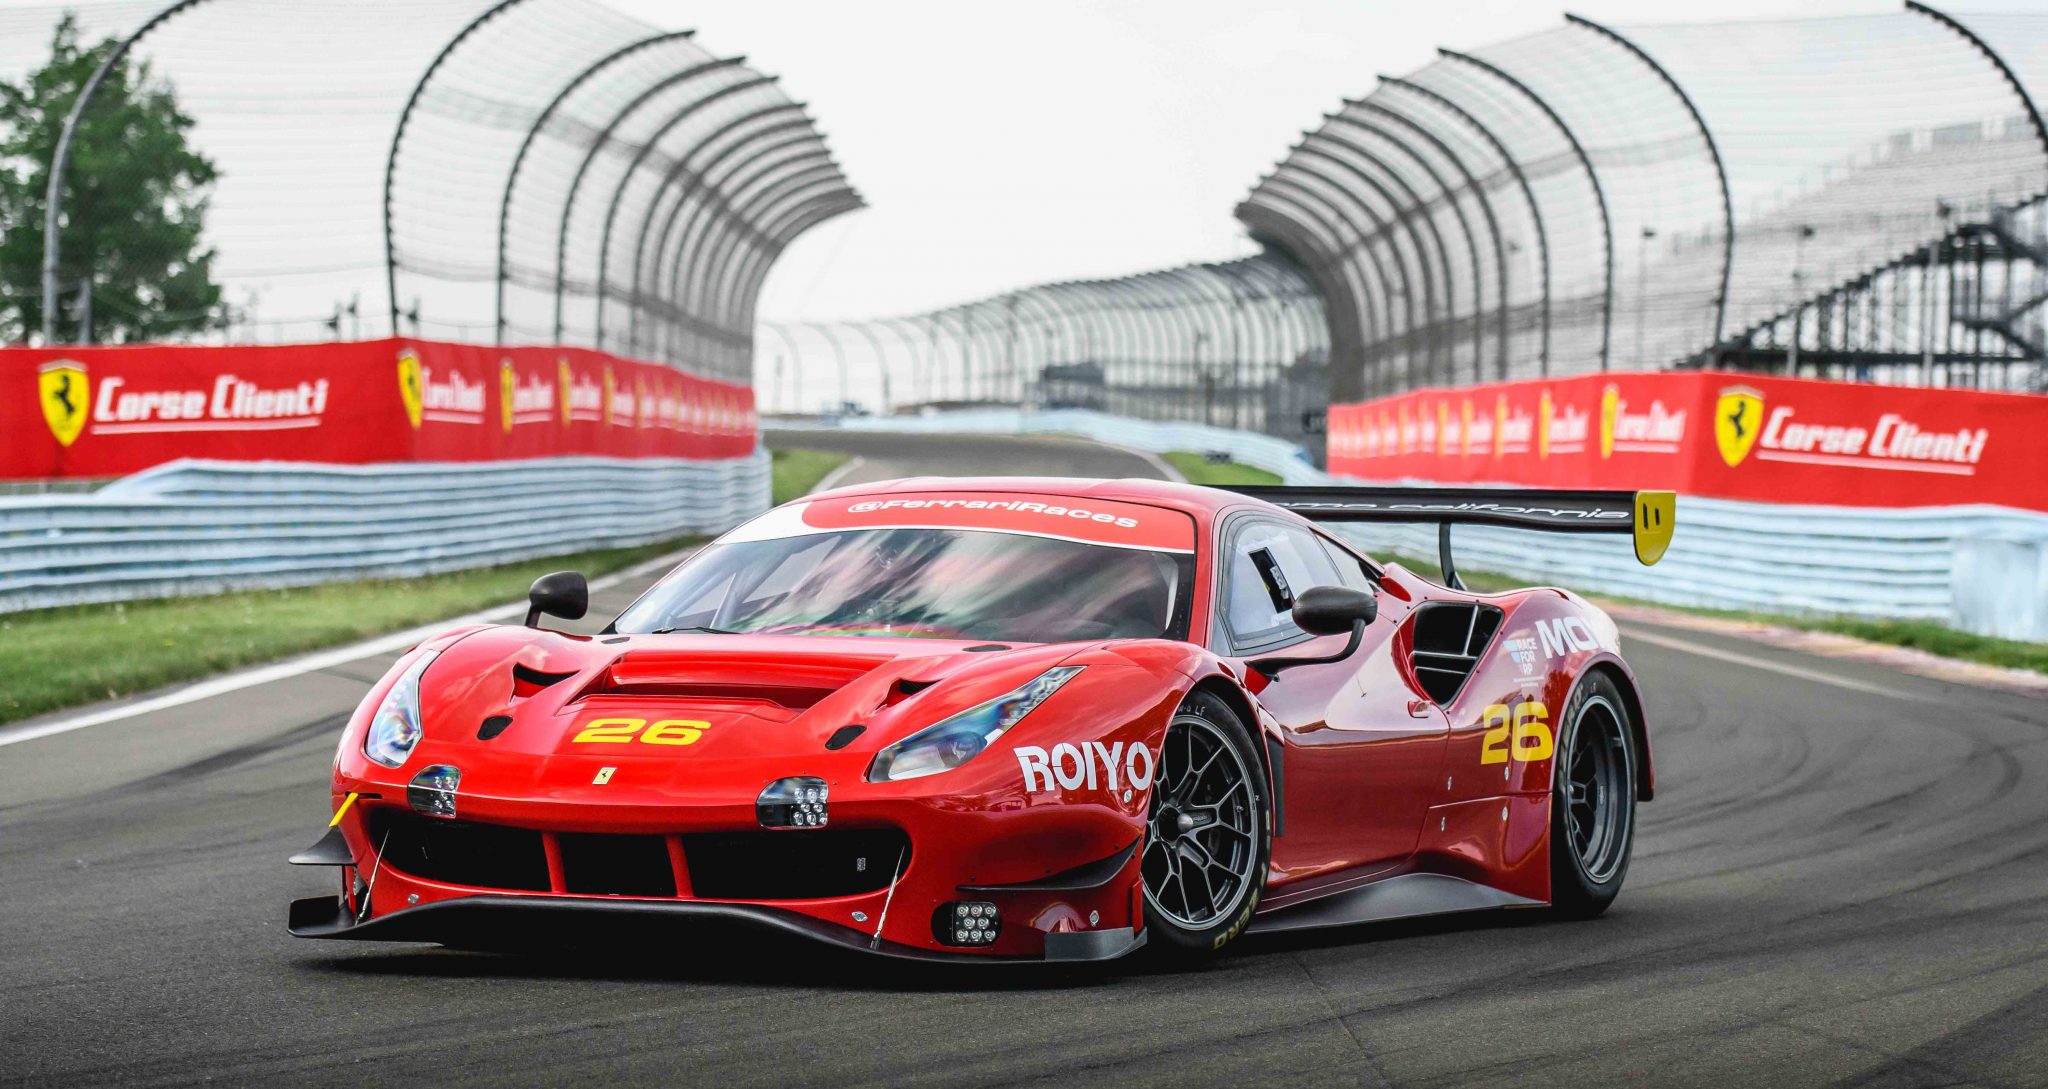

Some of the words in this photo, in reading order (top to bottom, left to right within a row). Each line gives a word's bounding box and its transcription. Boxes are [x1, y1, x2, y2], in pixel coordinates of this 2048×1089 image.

[94, 377, 207, 422] Corse
[210, 374, 329, 418] Clienti
[1760, 406, 1868, 455] Corse
[1868, 413, 1988, 464] Clienti
[848, 500, 1138, 528] @FerrariRaces
[572, 718, 712, 745] 26
[1481, 701, 1554, 765] 26
[1013, 741, 1153, 792] ROIYO
